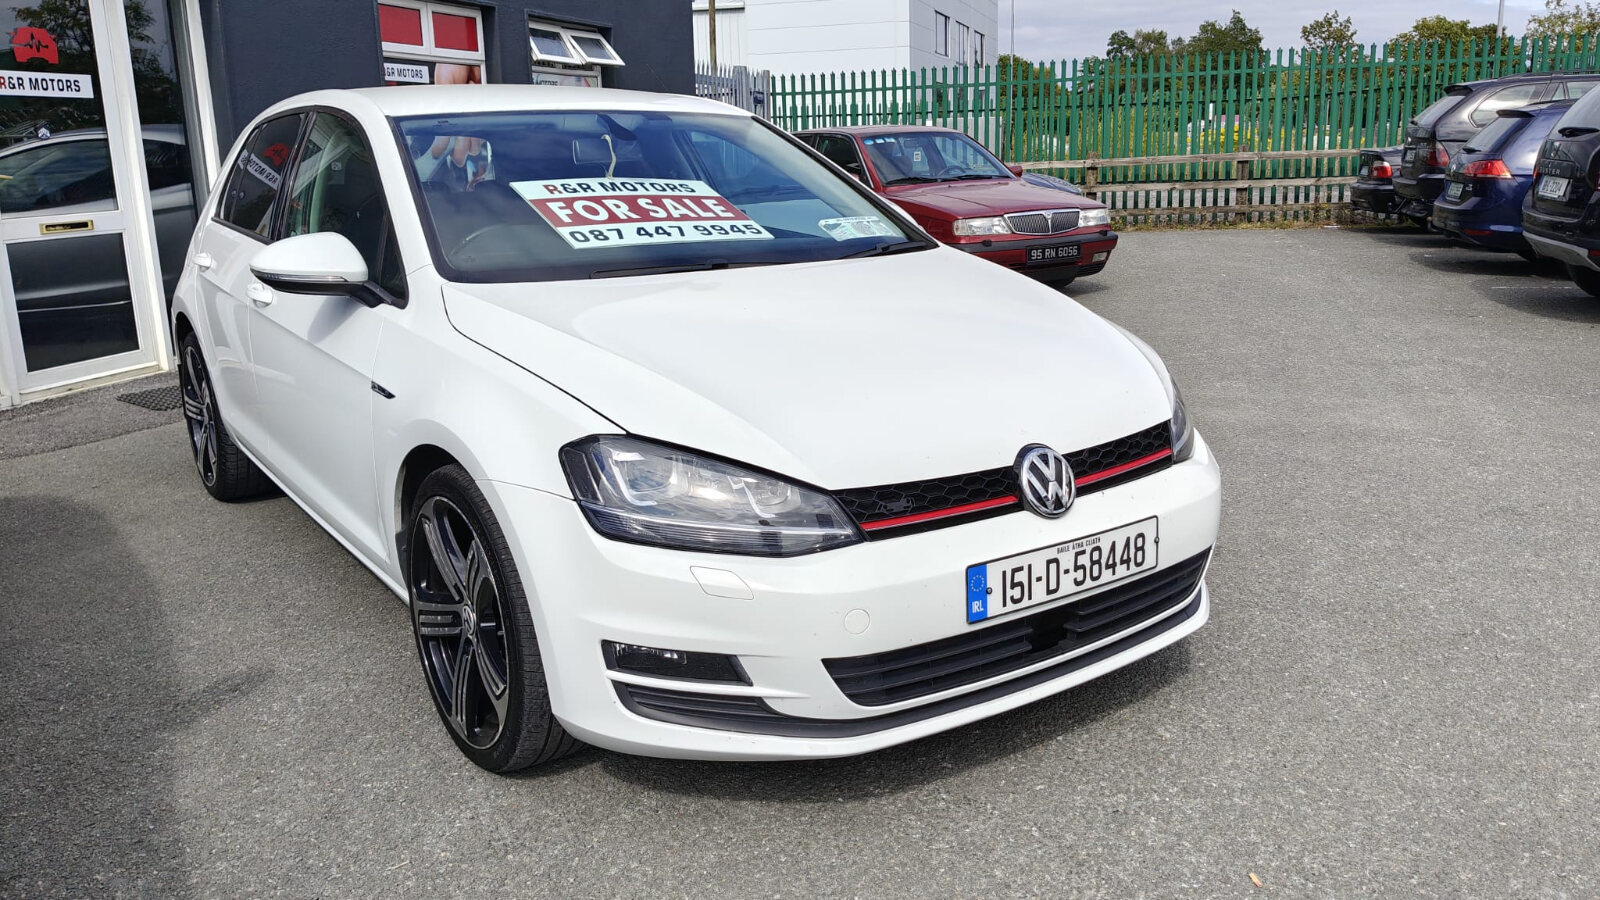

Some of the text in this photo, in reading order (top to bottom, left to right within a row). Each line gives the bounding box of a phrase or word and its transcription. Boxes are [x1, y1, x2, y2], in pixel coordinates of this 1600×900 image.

[397, 68, 423, 79] MOTORS
[0, 76, 81, 92] R&R MOTORS
[543, 182, 697, 194] R&R MOTORS
[546, 197, 735, 223] FOR SALE
[569, 223, 763, 243] 087 447 9945
[1031, 245, 1078, 260] 95 RN 6056
[1057, 545, 1070, 554] BAILE
[1002, 532, 1146, 607] 151-D-58448
[971, 600, 984, 614] IRL
